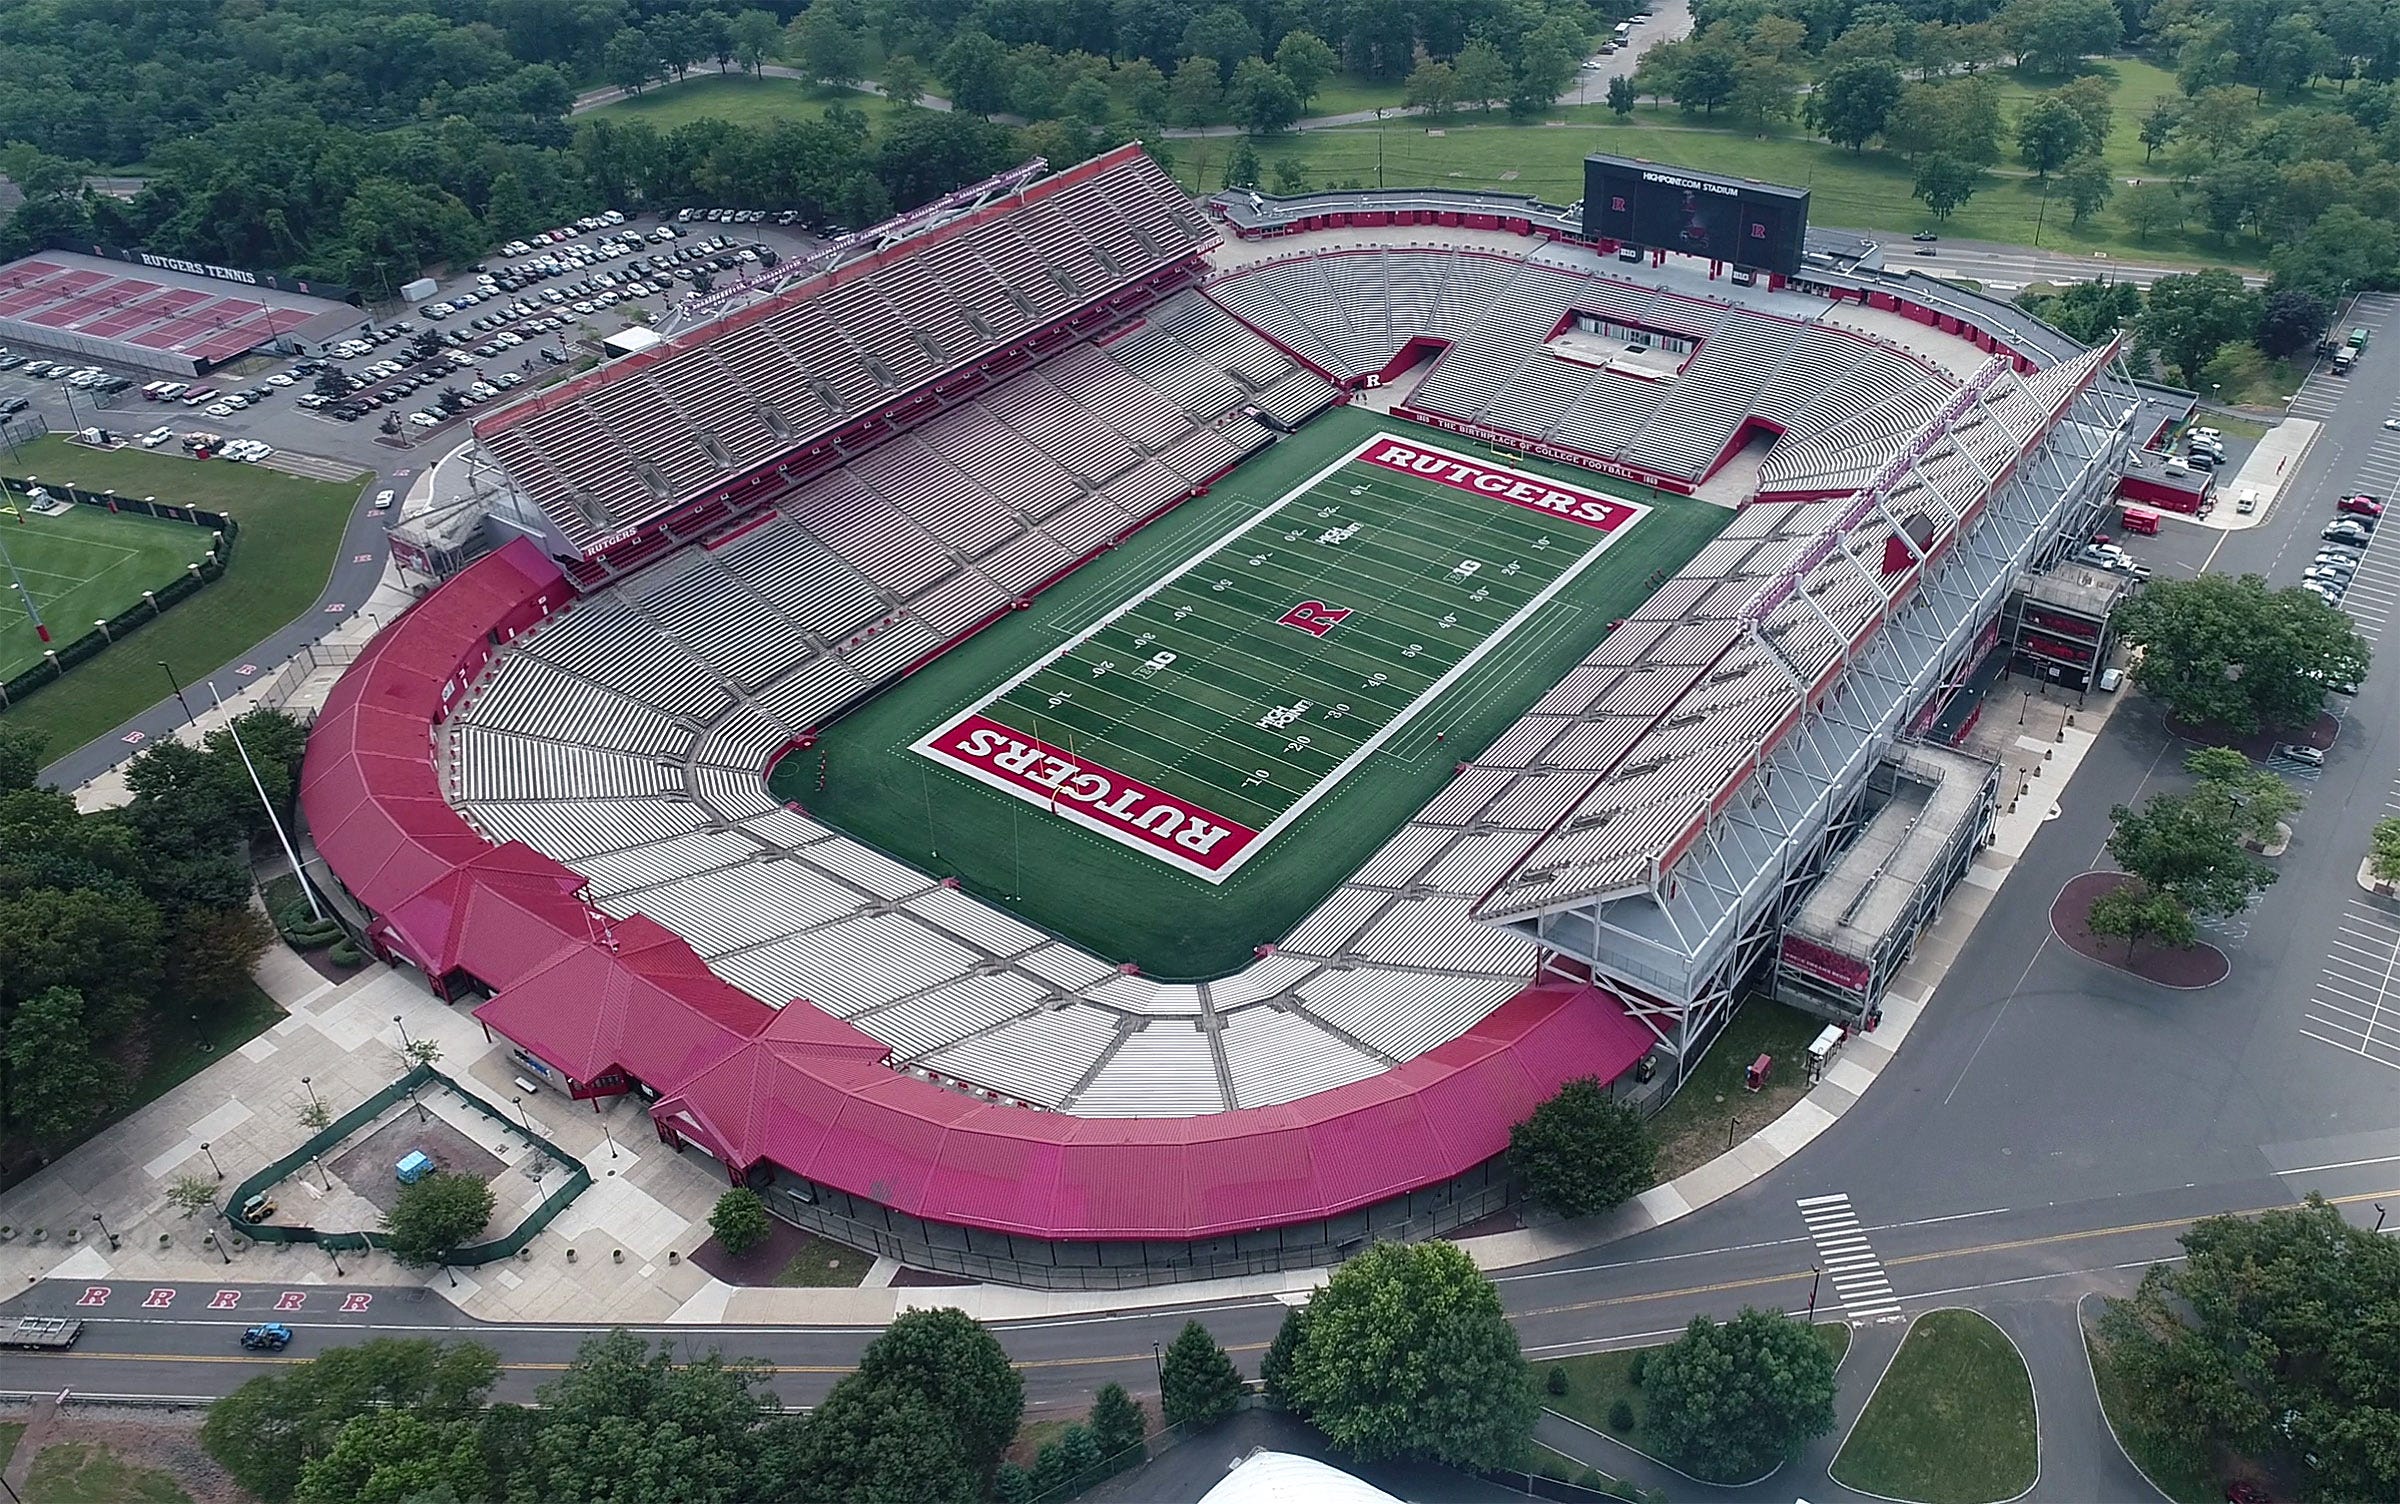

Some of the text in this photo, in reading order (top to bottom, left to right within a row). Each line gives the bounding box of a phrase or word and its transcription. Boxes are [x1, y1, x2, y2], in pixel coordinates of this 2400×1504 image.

[1643, 172, 1738, 197] HIGHPOINT.COM STADIUM
[1611, 197, 1626, 212] R
[1751, 223, 1766, 239] R
[141, 253, 256, 285] RUTGERS TENNIS
[1366, 374, 1382, 388] R
[1439, 419, 1456, 431] THE
[1460, 425, 1517, 447] BIRTHPLACE
[1519, 442, 1533, 451] OF
[1535, 446, 1579, 464] COLLEGE
[1583, 458, 1634, 479] FOOTBALL
[1350, 484, 1368, 496] 10
[1376, 445, 1614, 522] RUTGERS
[1317, 506, 1337, 518] 20
[587, 527, 637, 556] RUTGERS
[1531, 538, 1551, 551] 10
[1249, 553, 1268, 566] 40
[1501, 561, 1521, 576] 20
[1212, 579, 1233, 592] 50
[1470, 588, 1489, 602] 30
[1174, 605, 1193, 618] 40
[1275, 600, 1355, 638] R
[1438, 615, 1457, 629] 40
[1134, 632, 1156, 646] 30
[1401, 643, 1423, 658] 50
[1092, 660, 1115, 676] 20
[1367, 673, 1388, 687] 40
[1048, 690, 1073, 707] 10
[1256, 705, 1289, 728] HIGH
[1273, 699, 1311, 729] POINT
[1328, 703, 1350, 719] 30
[1288, 735, 1311, 752] 20
[1246, 769, 1270, 787] 10
[956, 729, 1232, 855] RUTGERS
[76, 1286, 111, 1306] R
[141, 1288, 176, 1308] R
[207, 1289, 241, 1309] R
[273, 1290, 306, 1311] R
[339, 1292, 372, 1312] R
